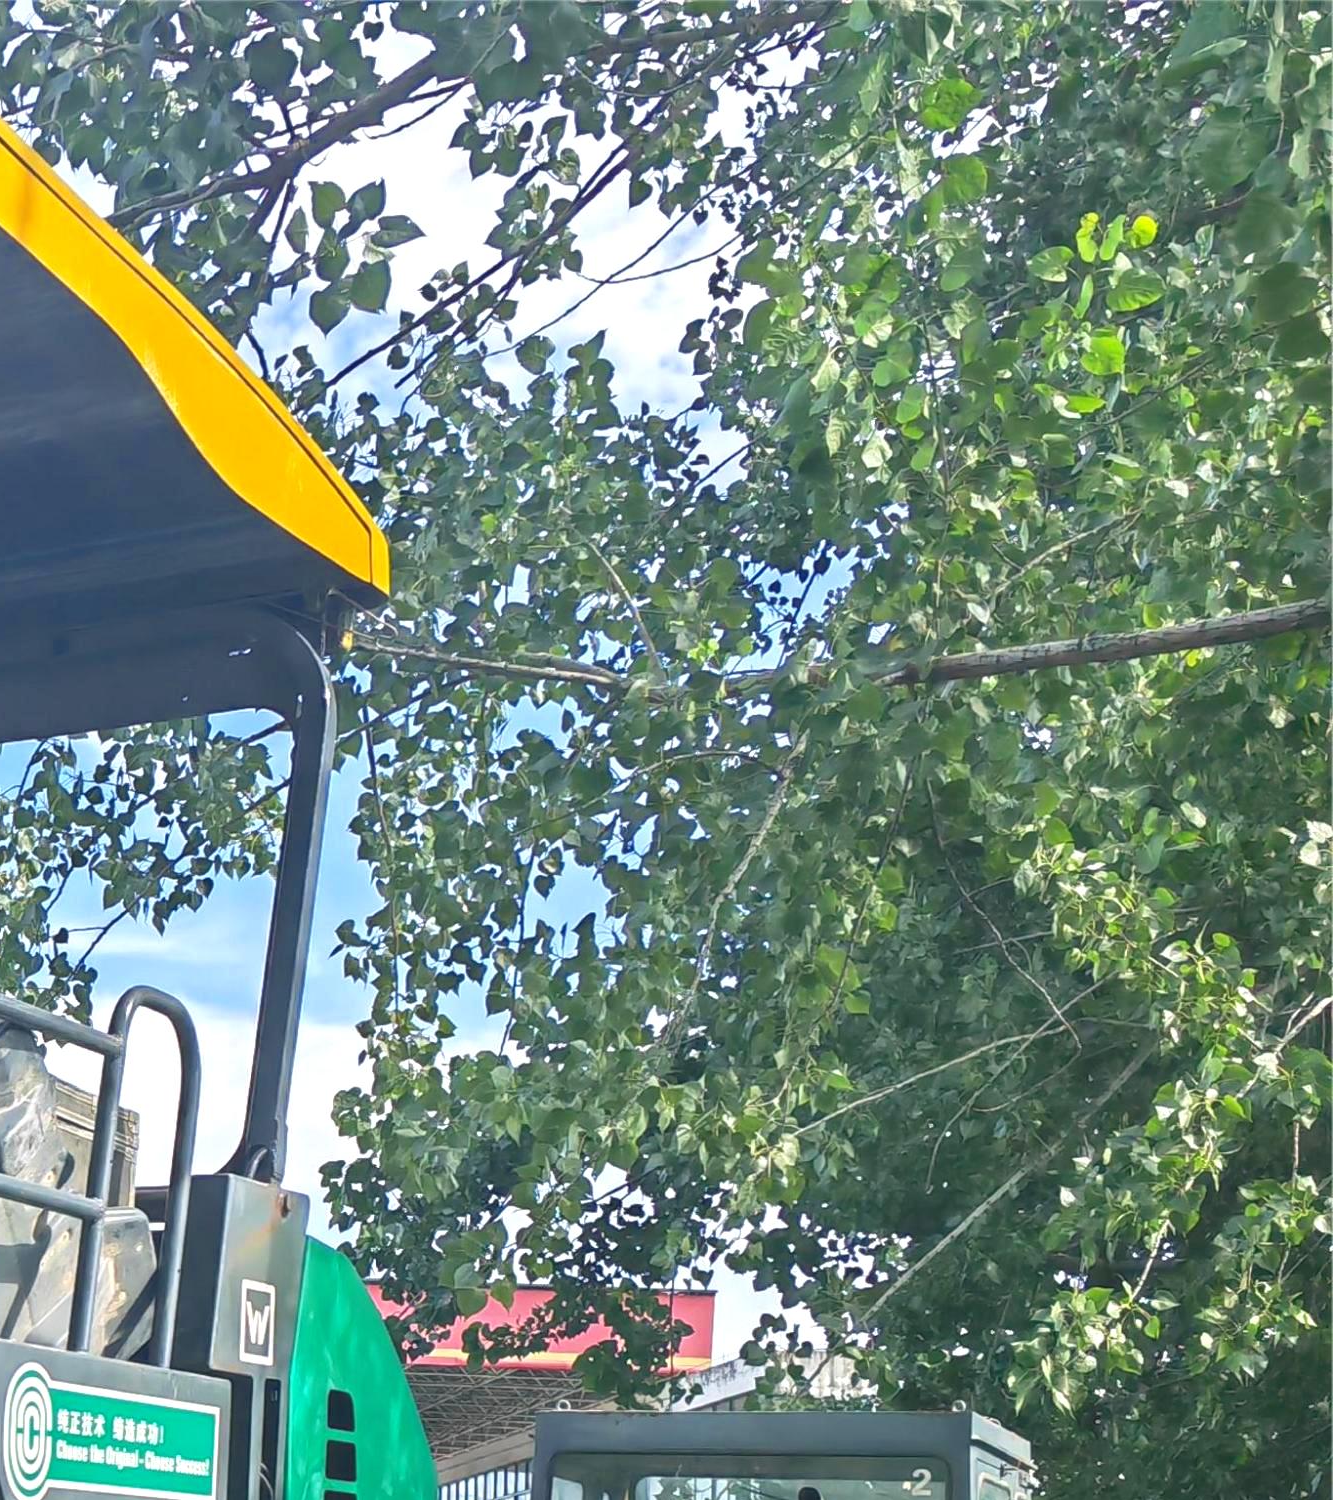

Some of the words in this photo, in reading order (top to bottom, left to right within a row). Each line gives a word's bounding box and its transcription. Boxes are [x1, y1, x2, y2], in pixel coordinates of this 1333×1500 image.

[56, 1440, 88, 1461] Choose
[90, 1444, 105, 1464] the
[106, 1445, 139, 1470] Original
[145, 1451, 175, 1471] Choose
[176, 1455, 210, 1476] Success!
